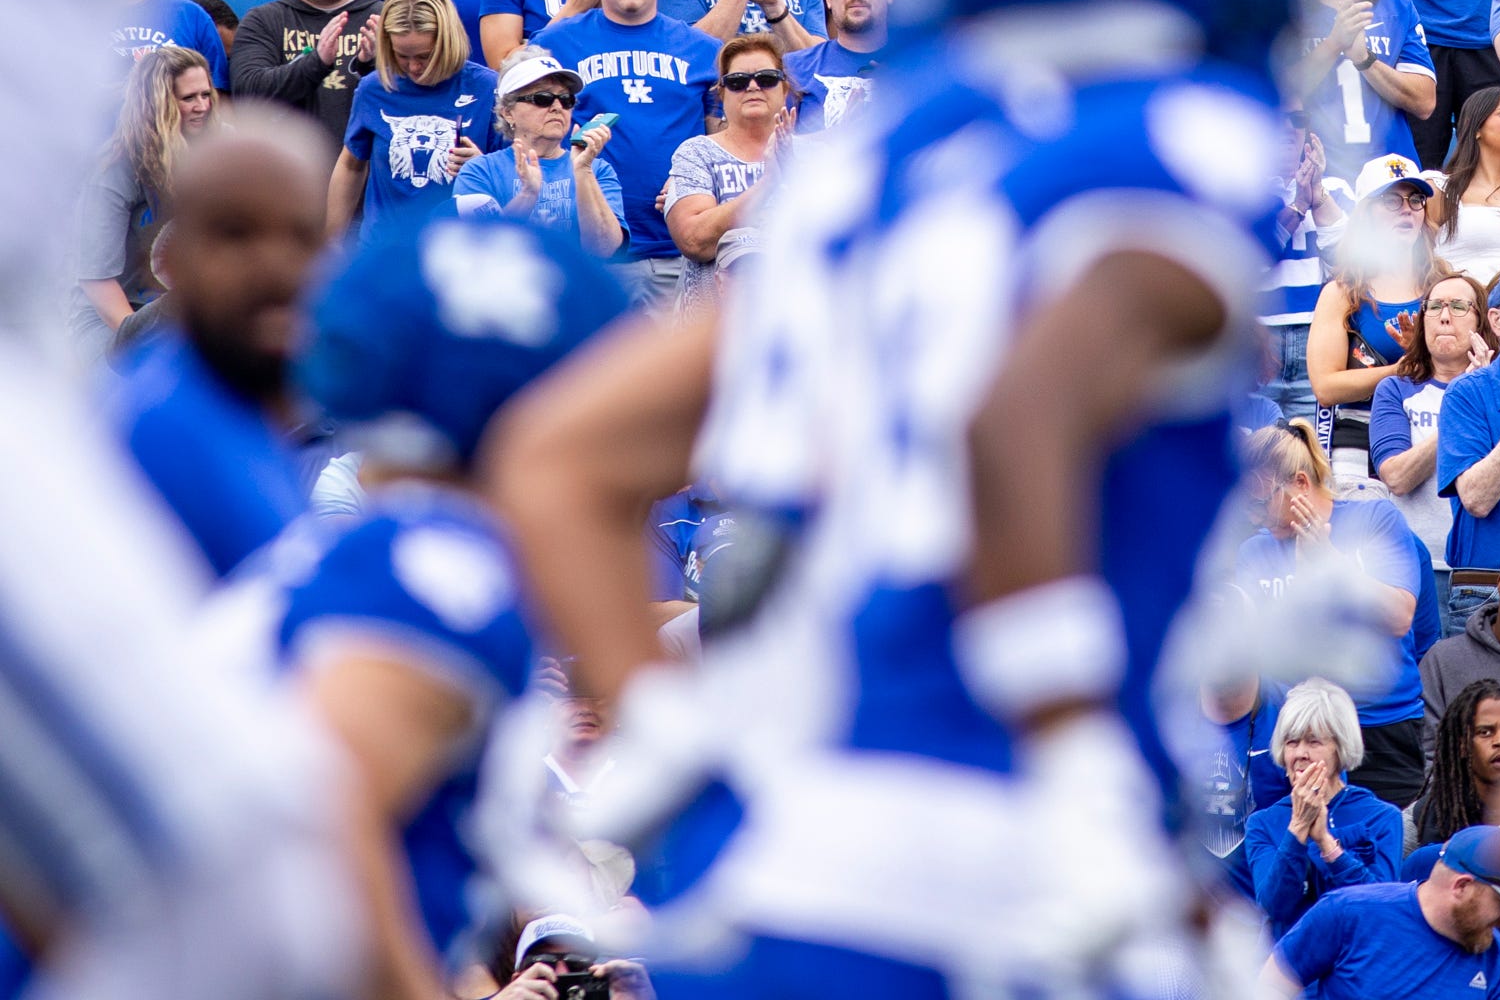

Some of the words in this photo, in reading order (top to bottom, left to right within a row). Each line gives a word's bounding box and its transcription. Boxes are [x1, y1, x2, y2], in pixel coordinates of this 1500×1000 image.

[578, 50, 690, 86] KENTUCKY
[621, 78, 654, 104] UK
[1337, 59, 1371, 144] 1
